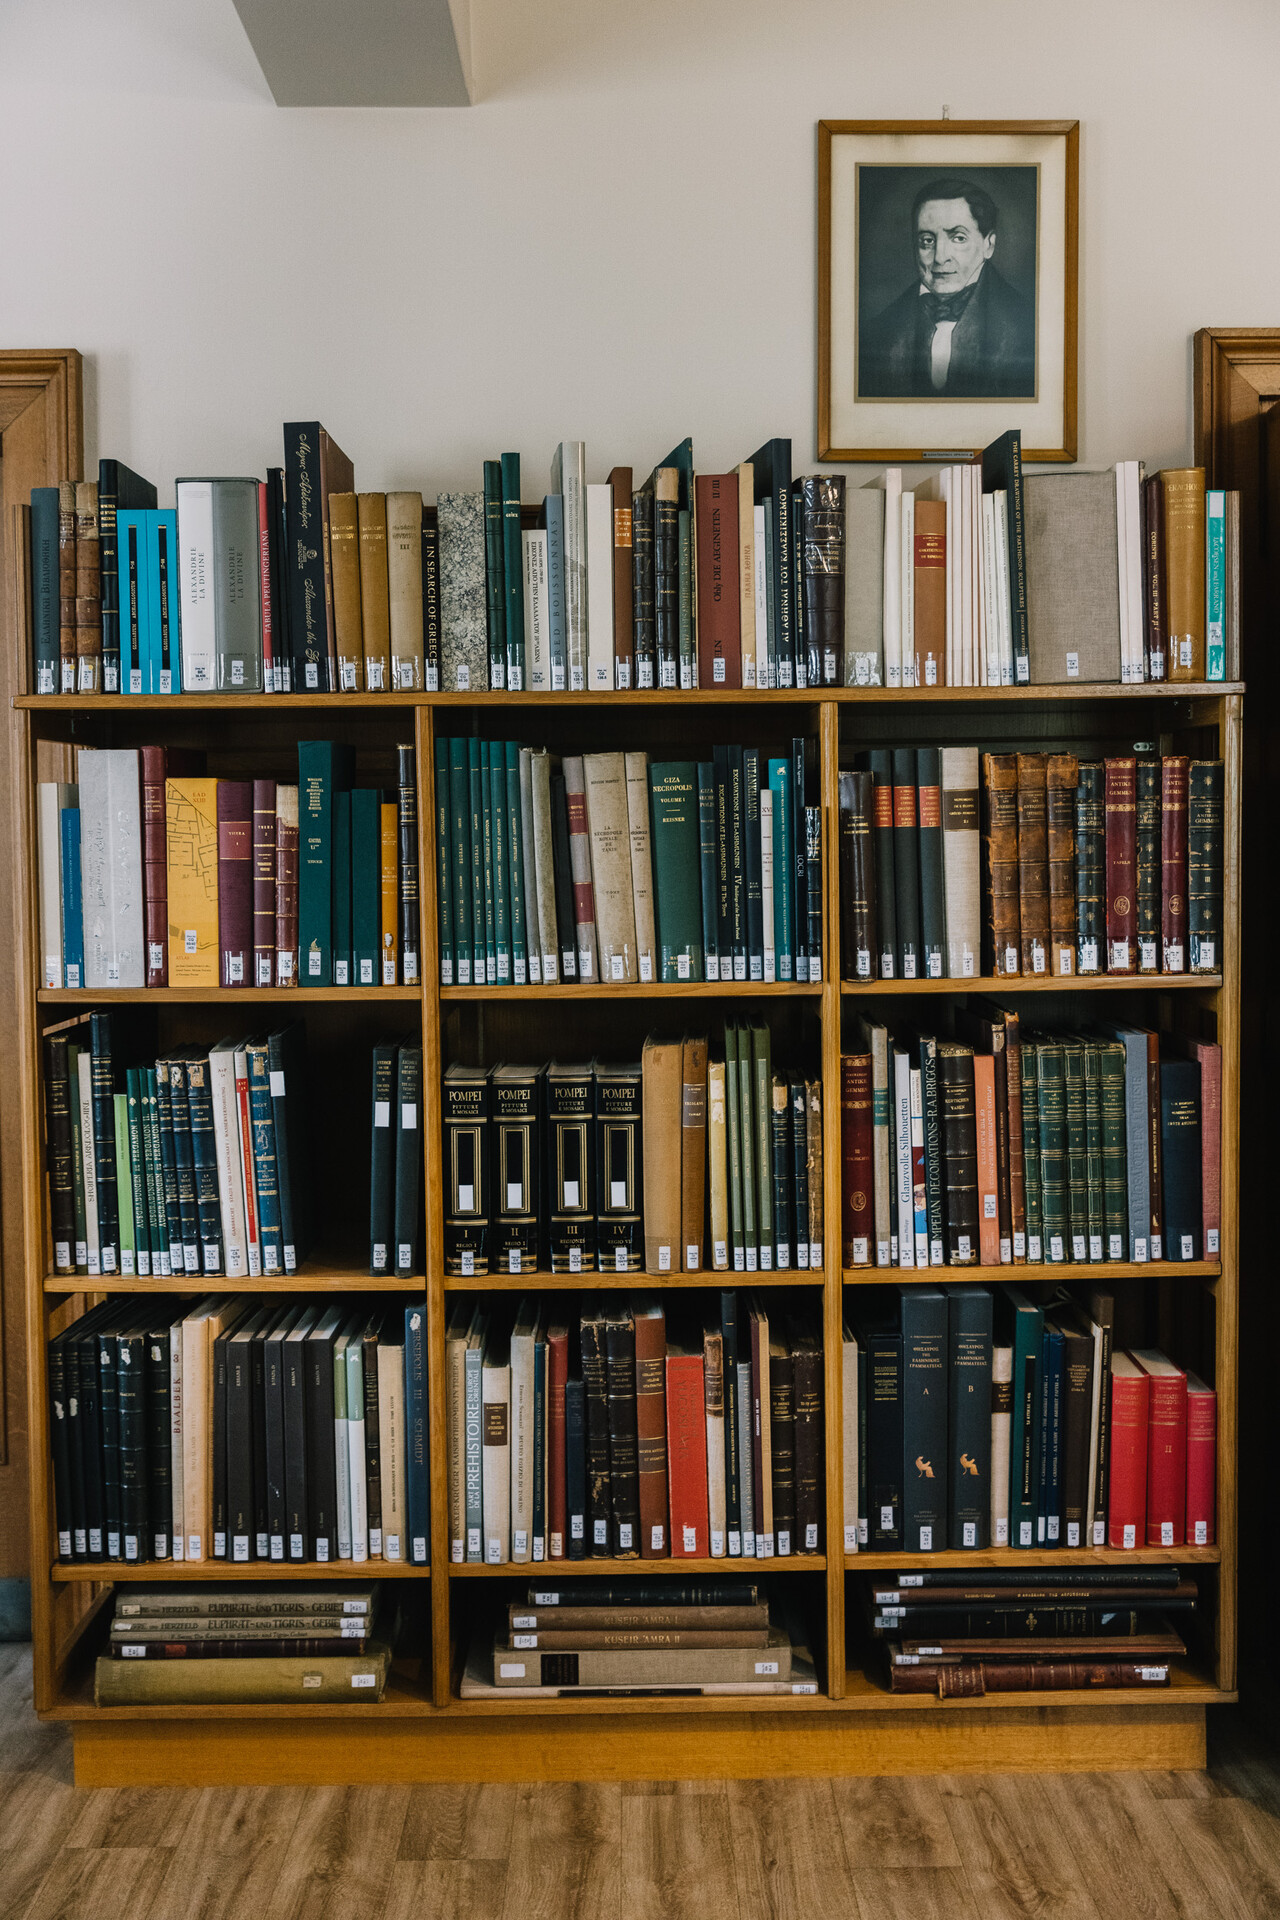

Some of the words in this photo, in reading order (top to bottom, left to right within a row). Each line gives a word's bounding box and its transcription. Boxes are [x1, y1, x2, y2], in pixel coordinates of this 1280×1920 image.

[426, 546, 435, 558] IN
[228, 546, 236, 604] ALEXANDRIE
[551, 520, 560, 618] BOISSONNAS
[190, 547, 198, 604] ALEXANDRIE
[426, 560, 436, 603] SEARCH
[199, 588, 206, 599] LA
[237, 588, 244, 599] LA
[428, 606, 436, 620] OF
[652, 784, 692, 792] NECROPOLIS
[748, 757, 758, 821] TUTANKHAMUN
[734, 812, 740, 821] AT
[720, 825, 725, 833] AT
[449, 1091, 482, 1102] POMPEI
[498, 1089, 530, 1101] POMPEI
[554, 1088, 588, 1099] POMPEI
[602, 1088, 636, 1100] POMPEI
[900, 1098, 909, 1150] Silhouetten
[900, 1152, 910, 1203] Glanzvolle
[414, 1389, 422, 1400] III
[414, 1418, 423, 1465] SCHMIDT
[466, 1403, 480, 1490] PREHISTOIRE
[474, 1490, 480, 1500] LA
[474, 1500, 480, 1508] DE
